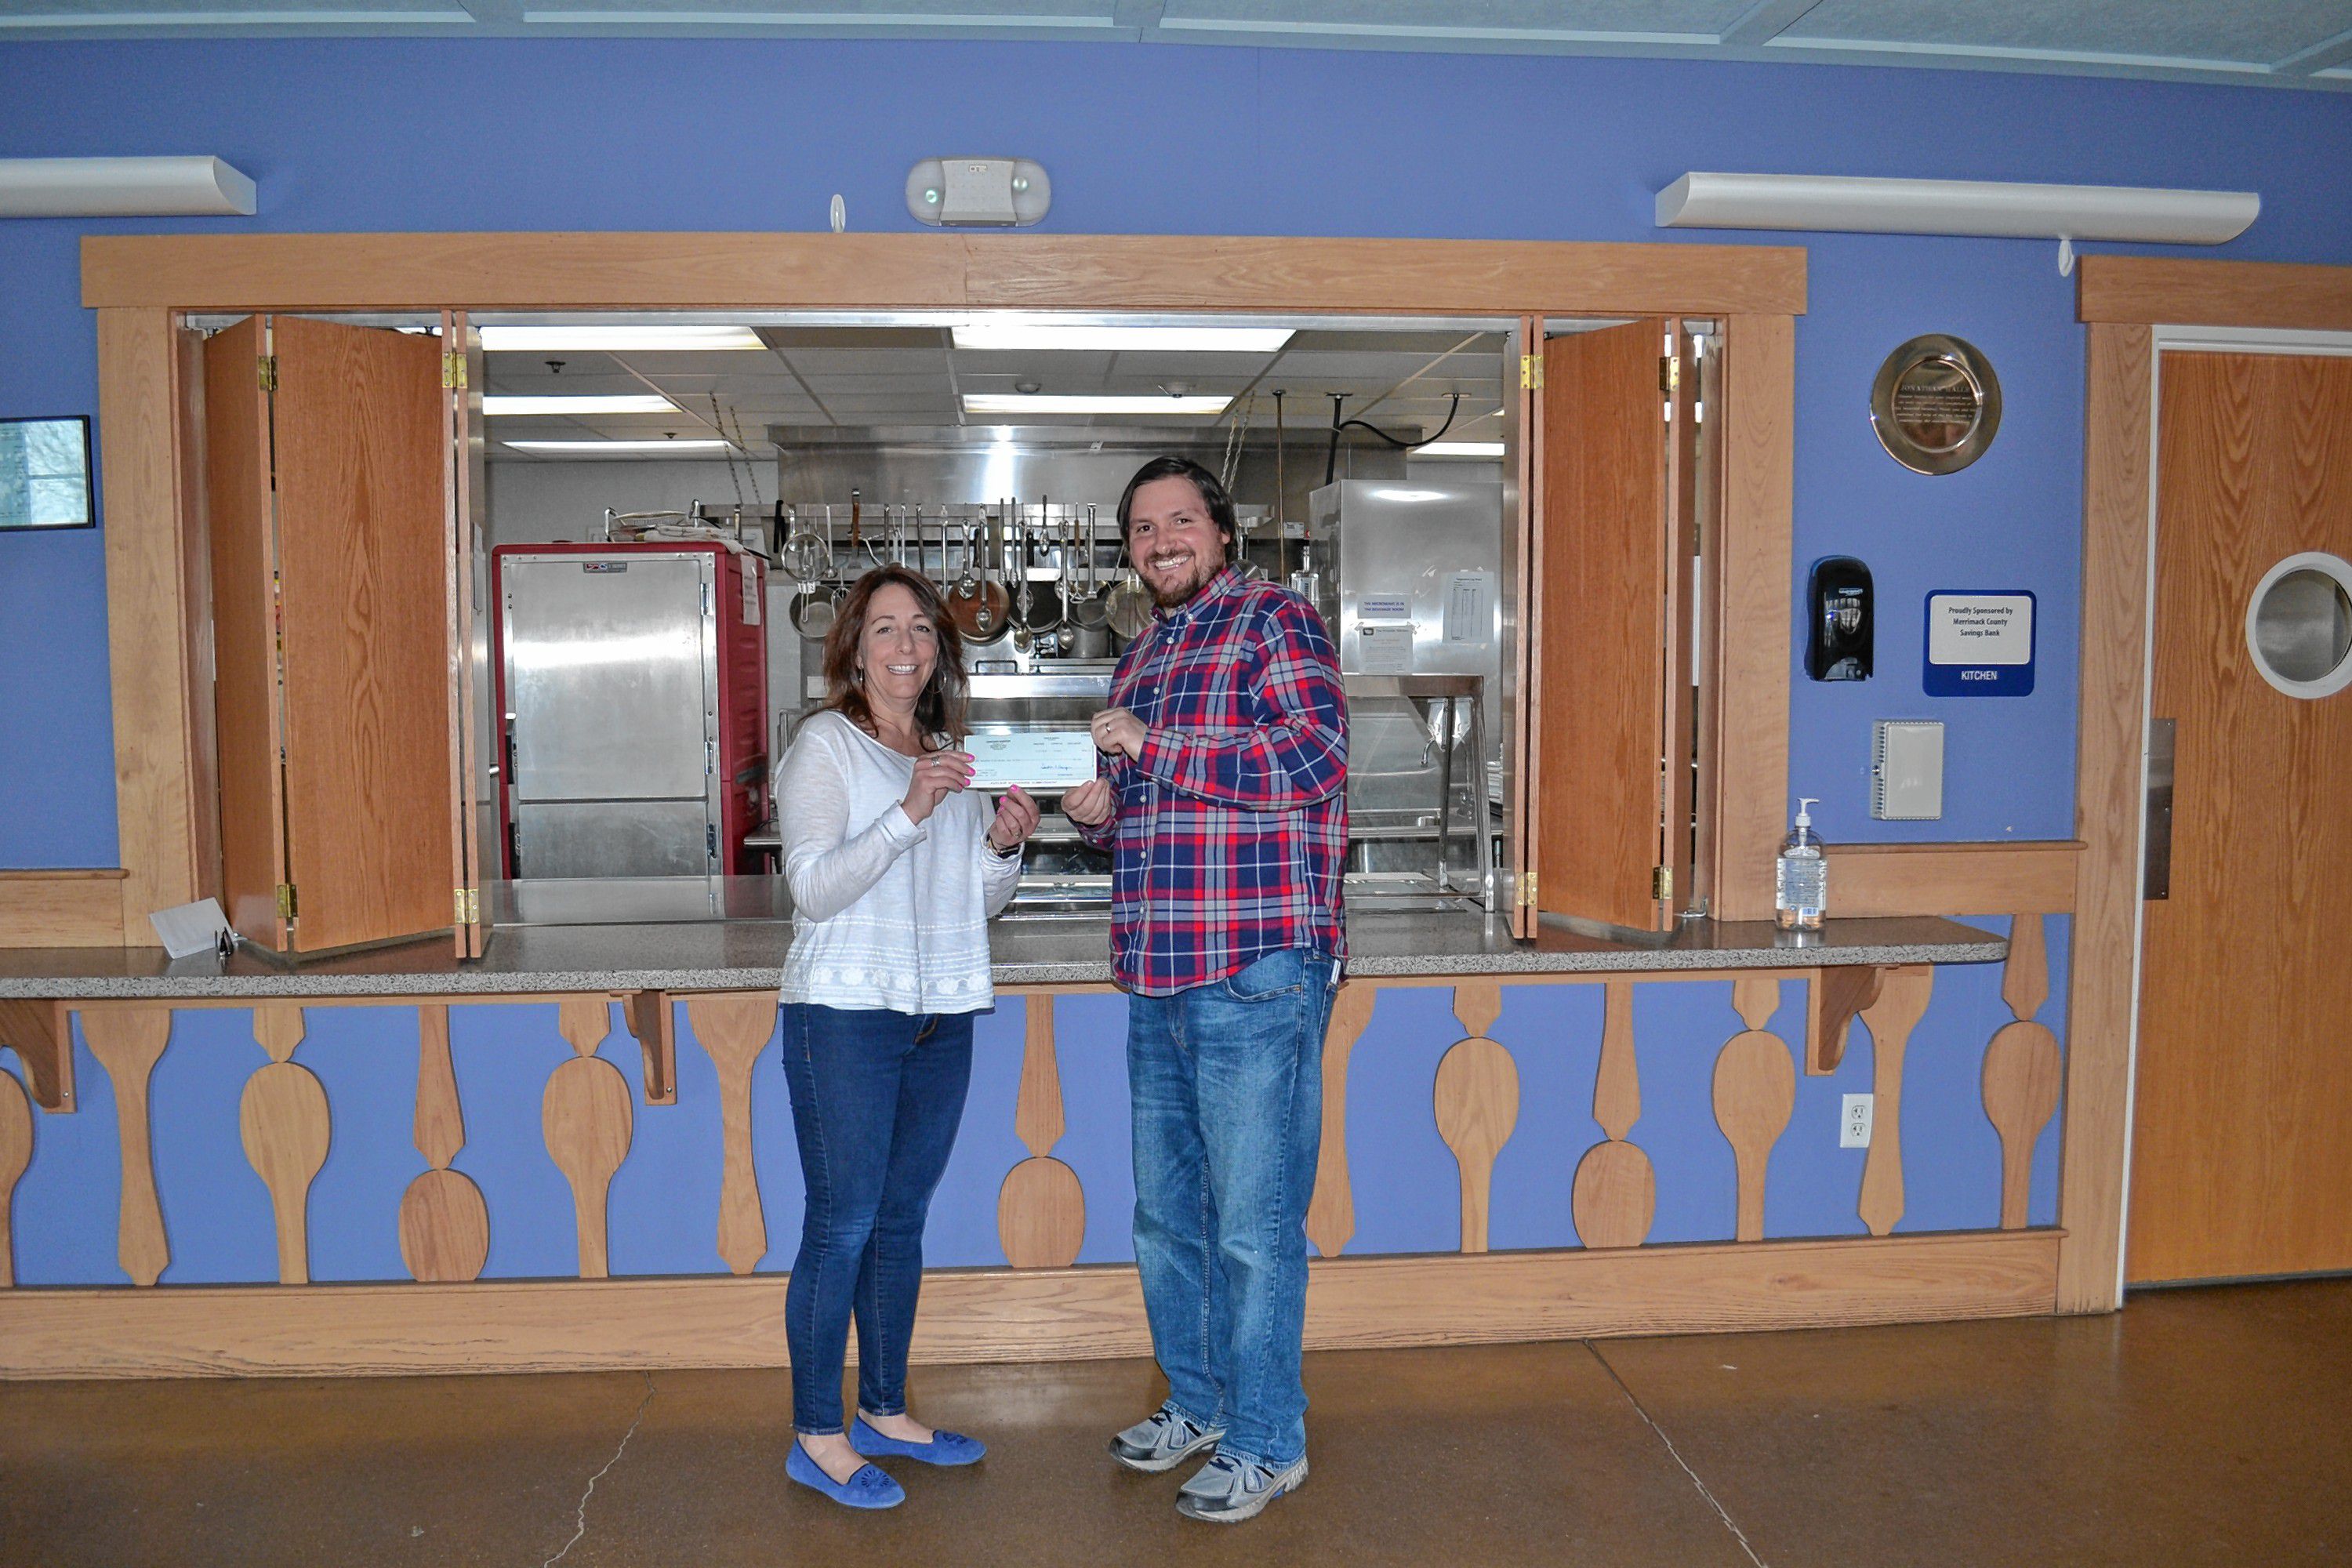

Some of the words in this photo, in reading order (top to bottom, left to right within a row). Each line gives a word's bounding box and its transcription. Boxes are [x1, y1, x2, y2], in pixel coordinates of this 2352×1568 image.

[1948, 607, 1971, 615] Proudly
[2005, 607, 2013, 615] by
[1986, 618, 2008, 626] County
[1961, 670, 1998, 681] KITCHEN
